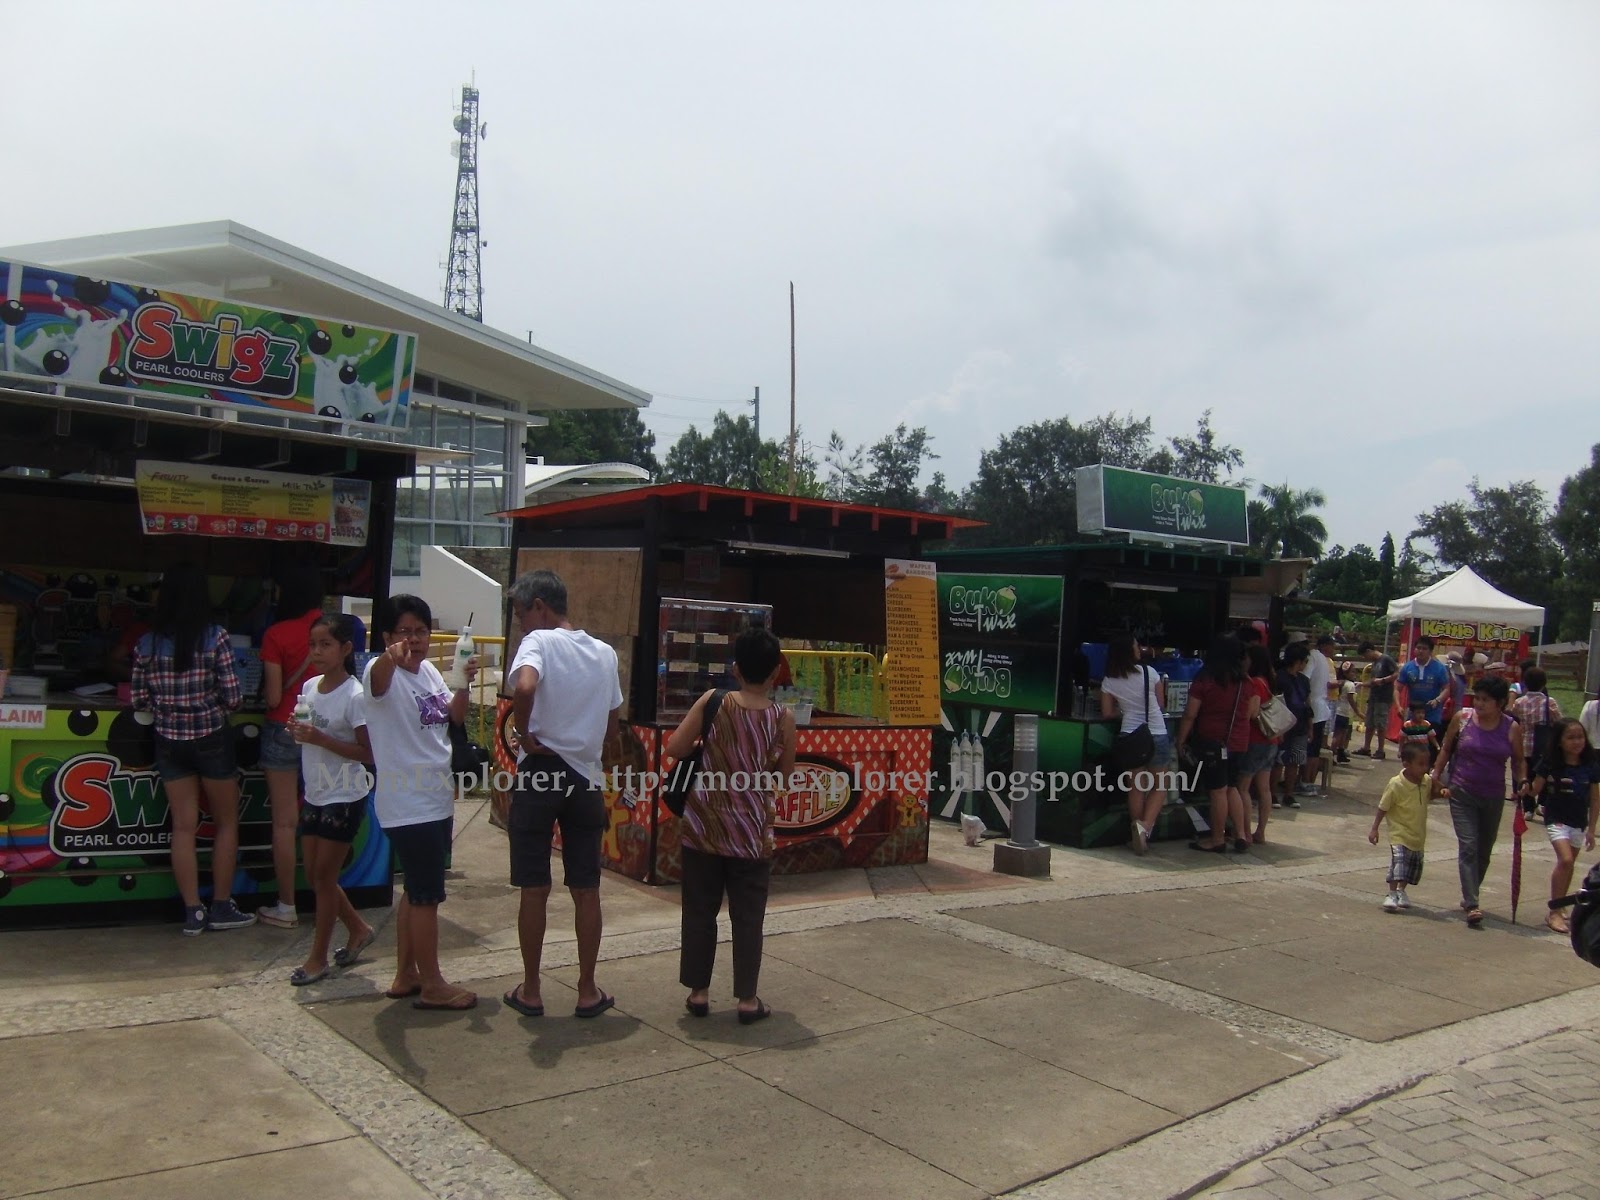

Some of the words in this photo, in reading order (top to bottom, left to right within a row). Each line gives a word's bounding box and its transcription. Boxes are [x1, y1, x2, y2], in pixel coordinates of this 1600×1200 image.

[132, 307, 296, 385] Swigz
[135, 360, 172, 375] PEARL
[173, 366, 225, 382] COOLERS
[1422, 619, 1474, 639] Kettle
[1479, 622, 1520, 640] Korn
[774, 790, 841, 823] AFFLE
[64, 834, 113, 847] PEARL
[116, 832, 173, 845] COOLE
